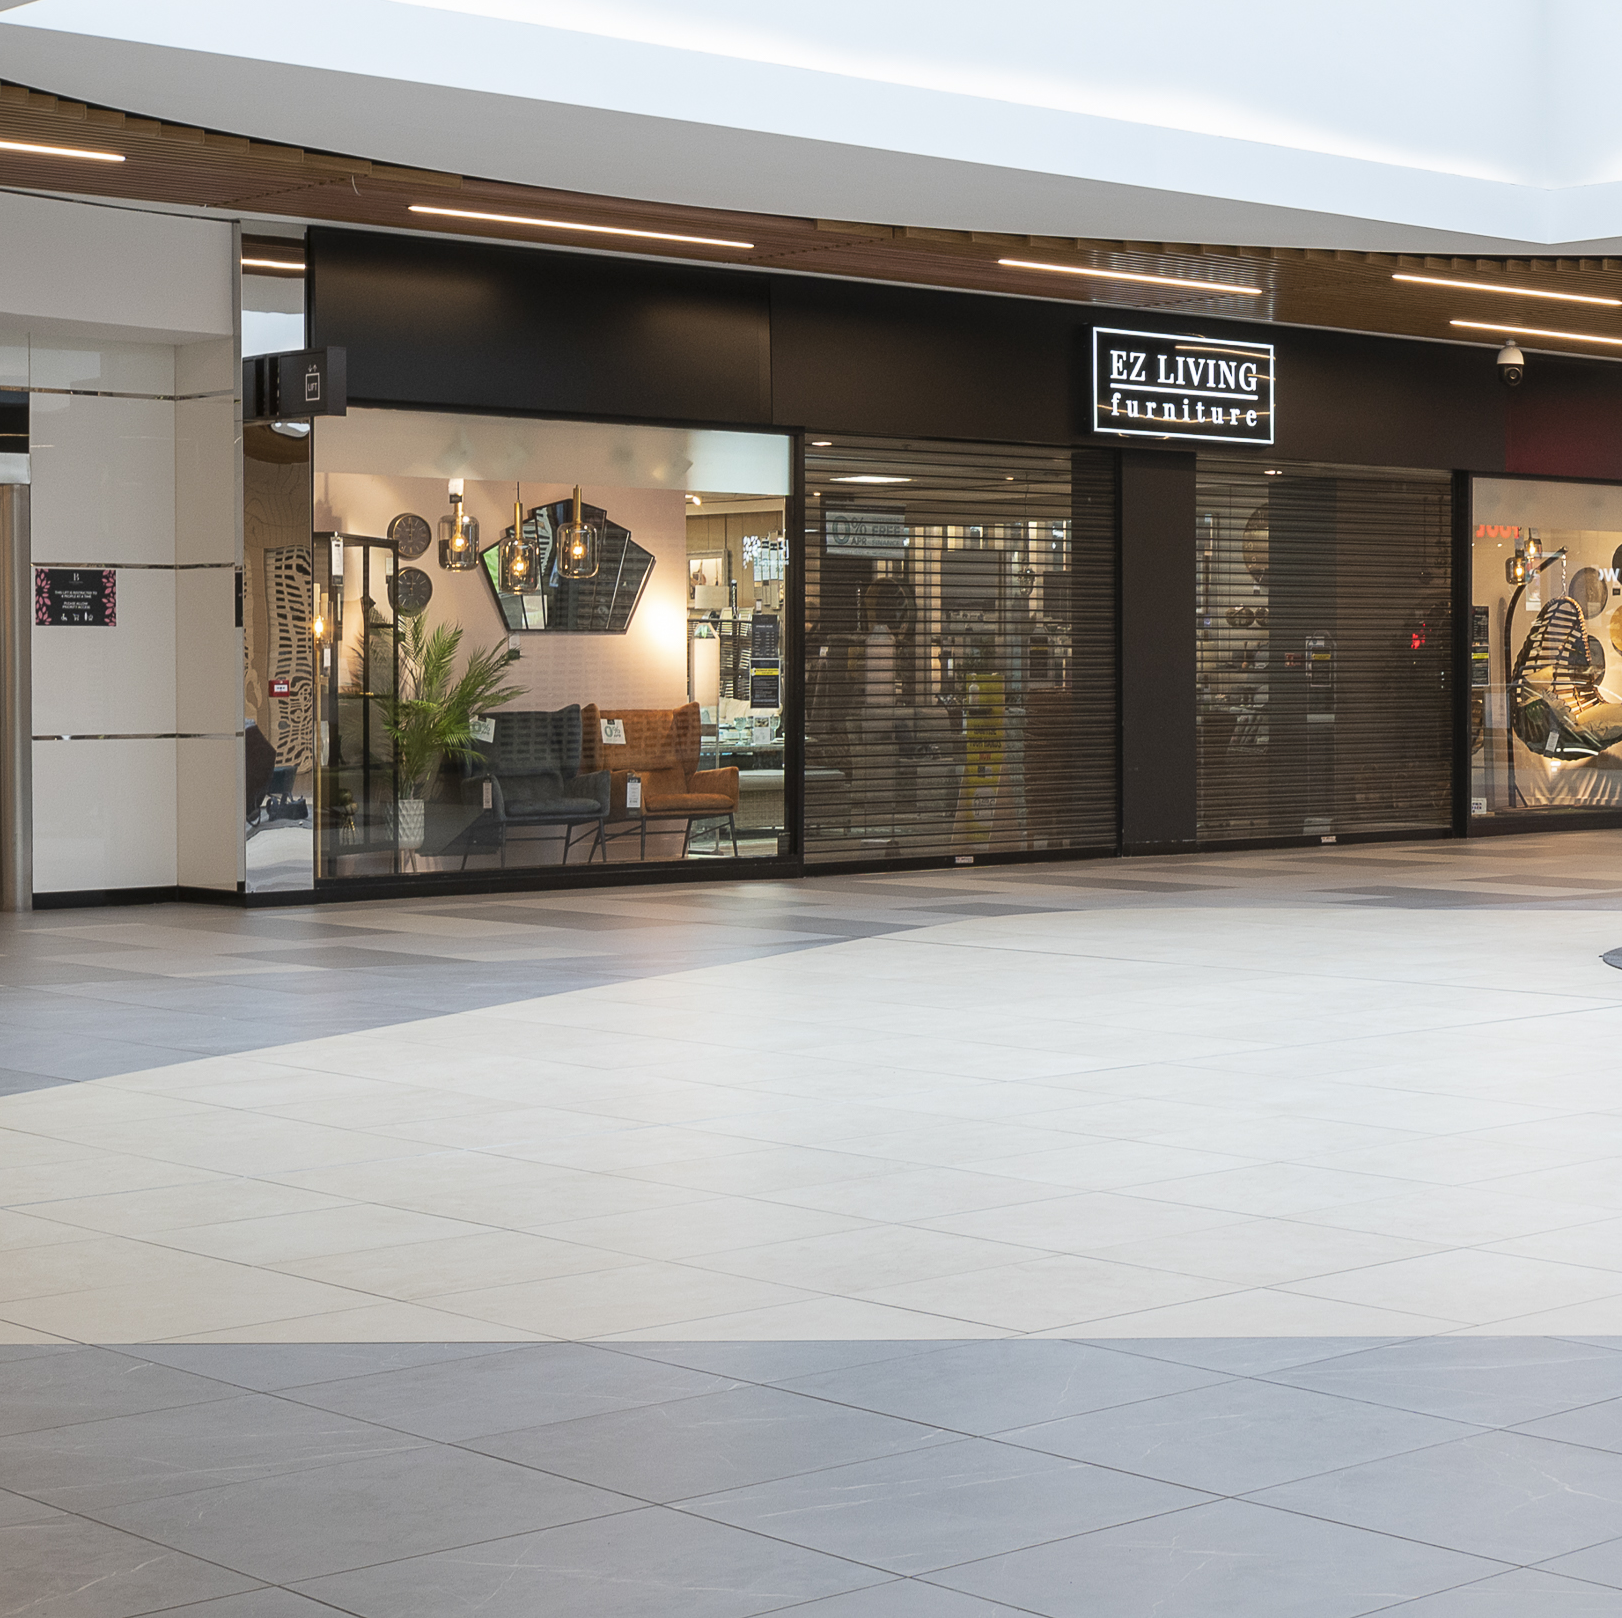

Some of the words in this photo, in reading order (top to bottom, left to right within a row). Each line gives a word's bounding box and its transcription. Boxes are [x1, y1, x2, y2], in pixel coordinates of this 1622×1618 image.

[1109, 349, 1146, 382] EZ
[1157, 354, 1258, 392] LIVING
[307, 382, 318, 392] LIFT
[1110, 392, 1258, 427] furniture
[604, 725, 621, 738] 0%
